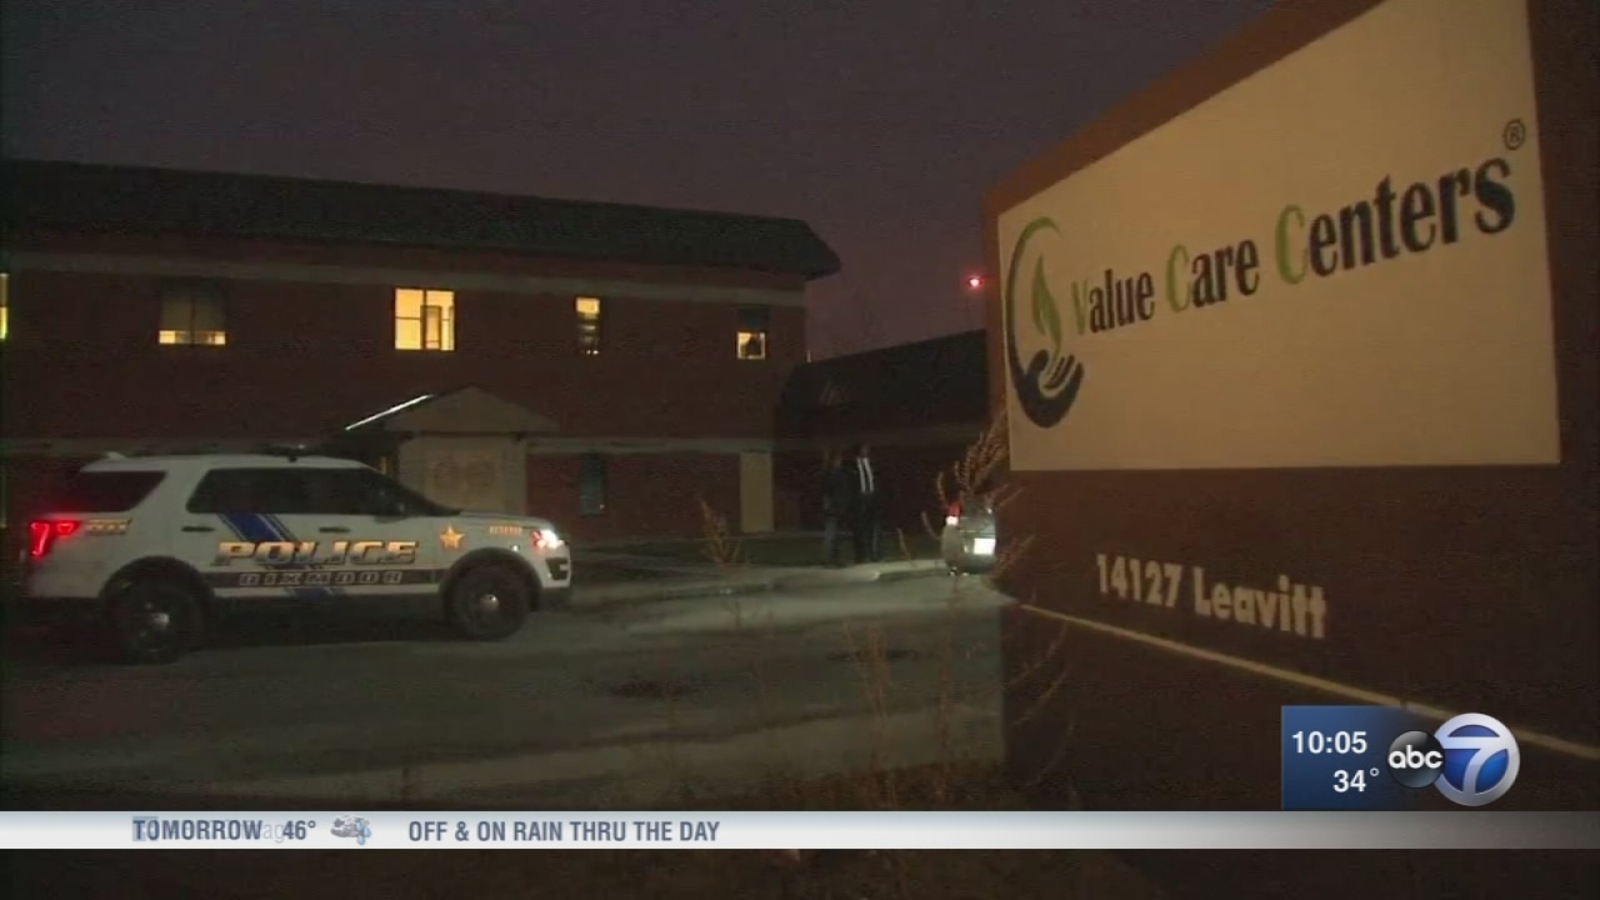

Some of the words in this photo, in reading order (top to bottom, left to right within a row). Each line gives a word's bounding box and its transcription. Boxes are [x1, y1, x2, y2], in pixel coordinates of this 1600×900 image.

[1070, 268, 1155, 336] Value
[1165, 238, 1260, 314] Care
[1274, 156, 1516, 285] Centers
[210, 541, 419, 567] POLICE
[239, 571, 403, 586] DIXMOOR
[1096, 553, 1183, 608] 14127
[1193, 566, 1327, 639] Leavitt
